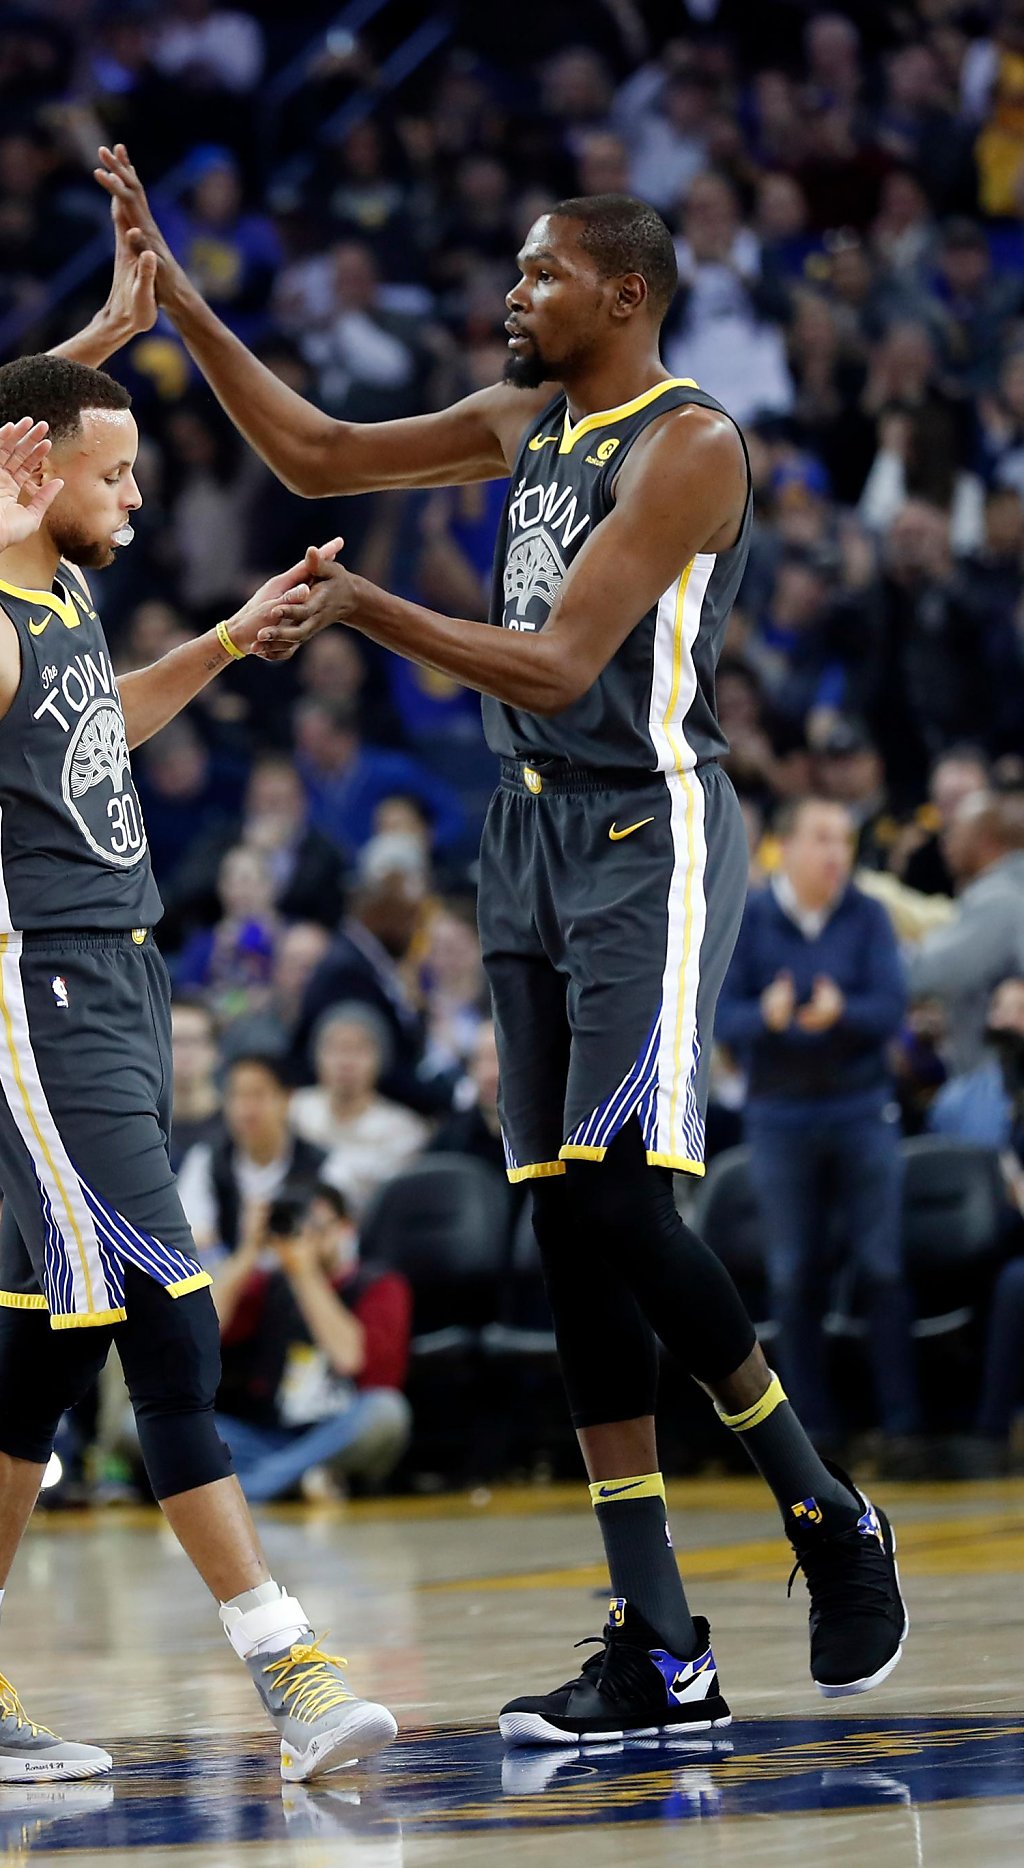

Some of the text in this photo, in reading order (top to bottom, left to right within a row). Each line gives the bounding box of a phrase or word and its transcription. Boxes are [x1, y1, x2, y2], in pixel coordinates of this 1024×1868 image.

[508, 482, 590, 548] TOWN
[41, 664, 58, 690] The
[107, 793, 141, 853] 30
